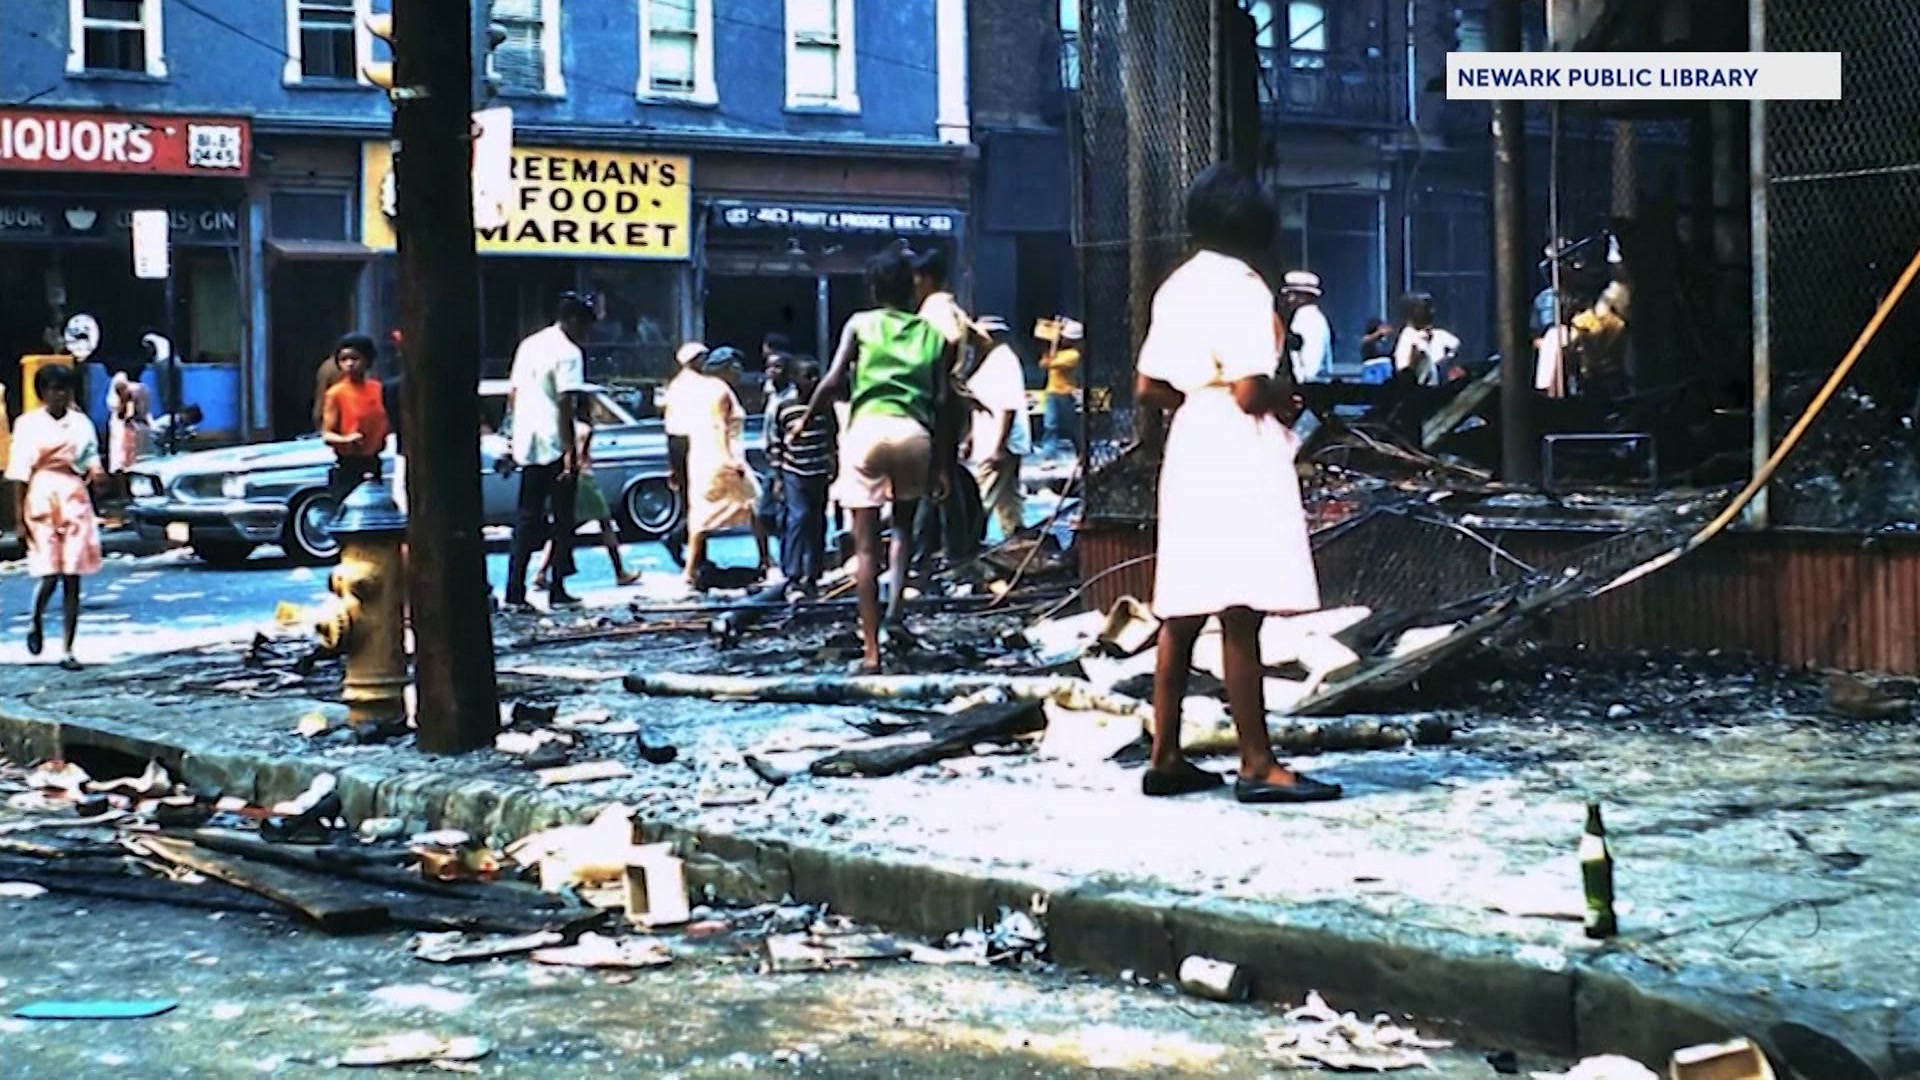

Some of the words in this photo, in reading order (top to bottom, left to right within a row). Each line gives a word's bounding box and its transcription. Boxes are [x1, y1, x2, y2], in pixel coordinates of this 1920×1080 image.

[0, 118, 154, 162] IQUORS
[510, 156, 676, 187] EEMAN'S
[520, 187, 639, 214] FOOD
[200, 210, 237, 231] GIN
[478, 219, 678, 247] MARKET
